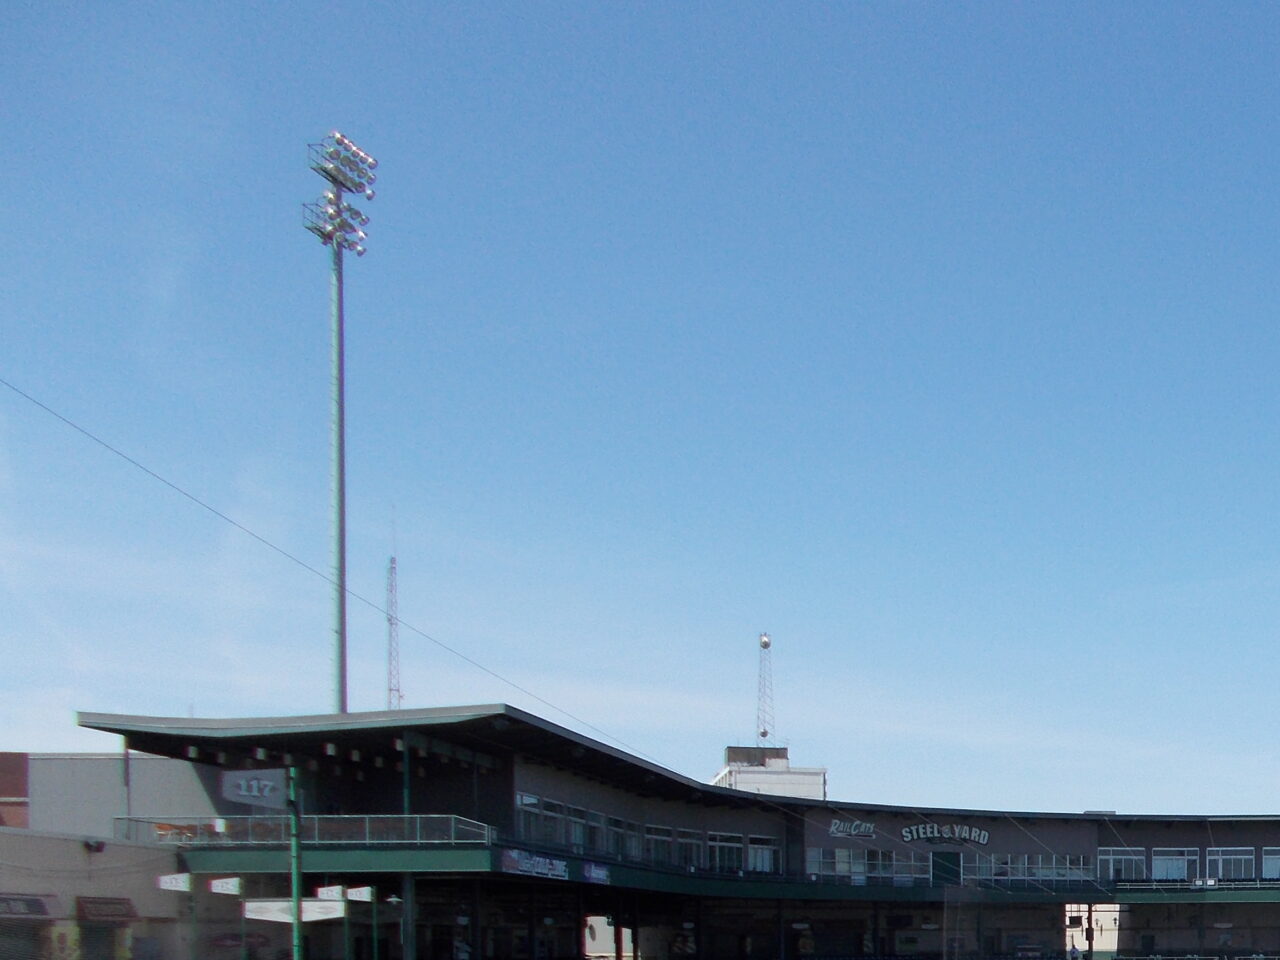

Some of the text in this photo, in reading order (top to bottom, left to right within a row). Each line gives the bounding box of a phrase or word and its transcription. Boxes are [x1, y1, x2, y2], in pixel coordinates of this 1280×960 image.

[238, 779, 274, 797] 117
[902, 824, 989, 845] STEEL YARD
